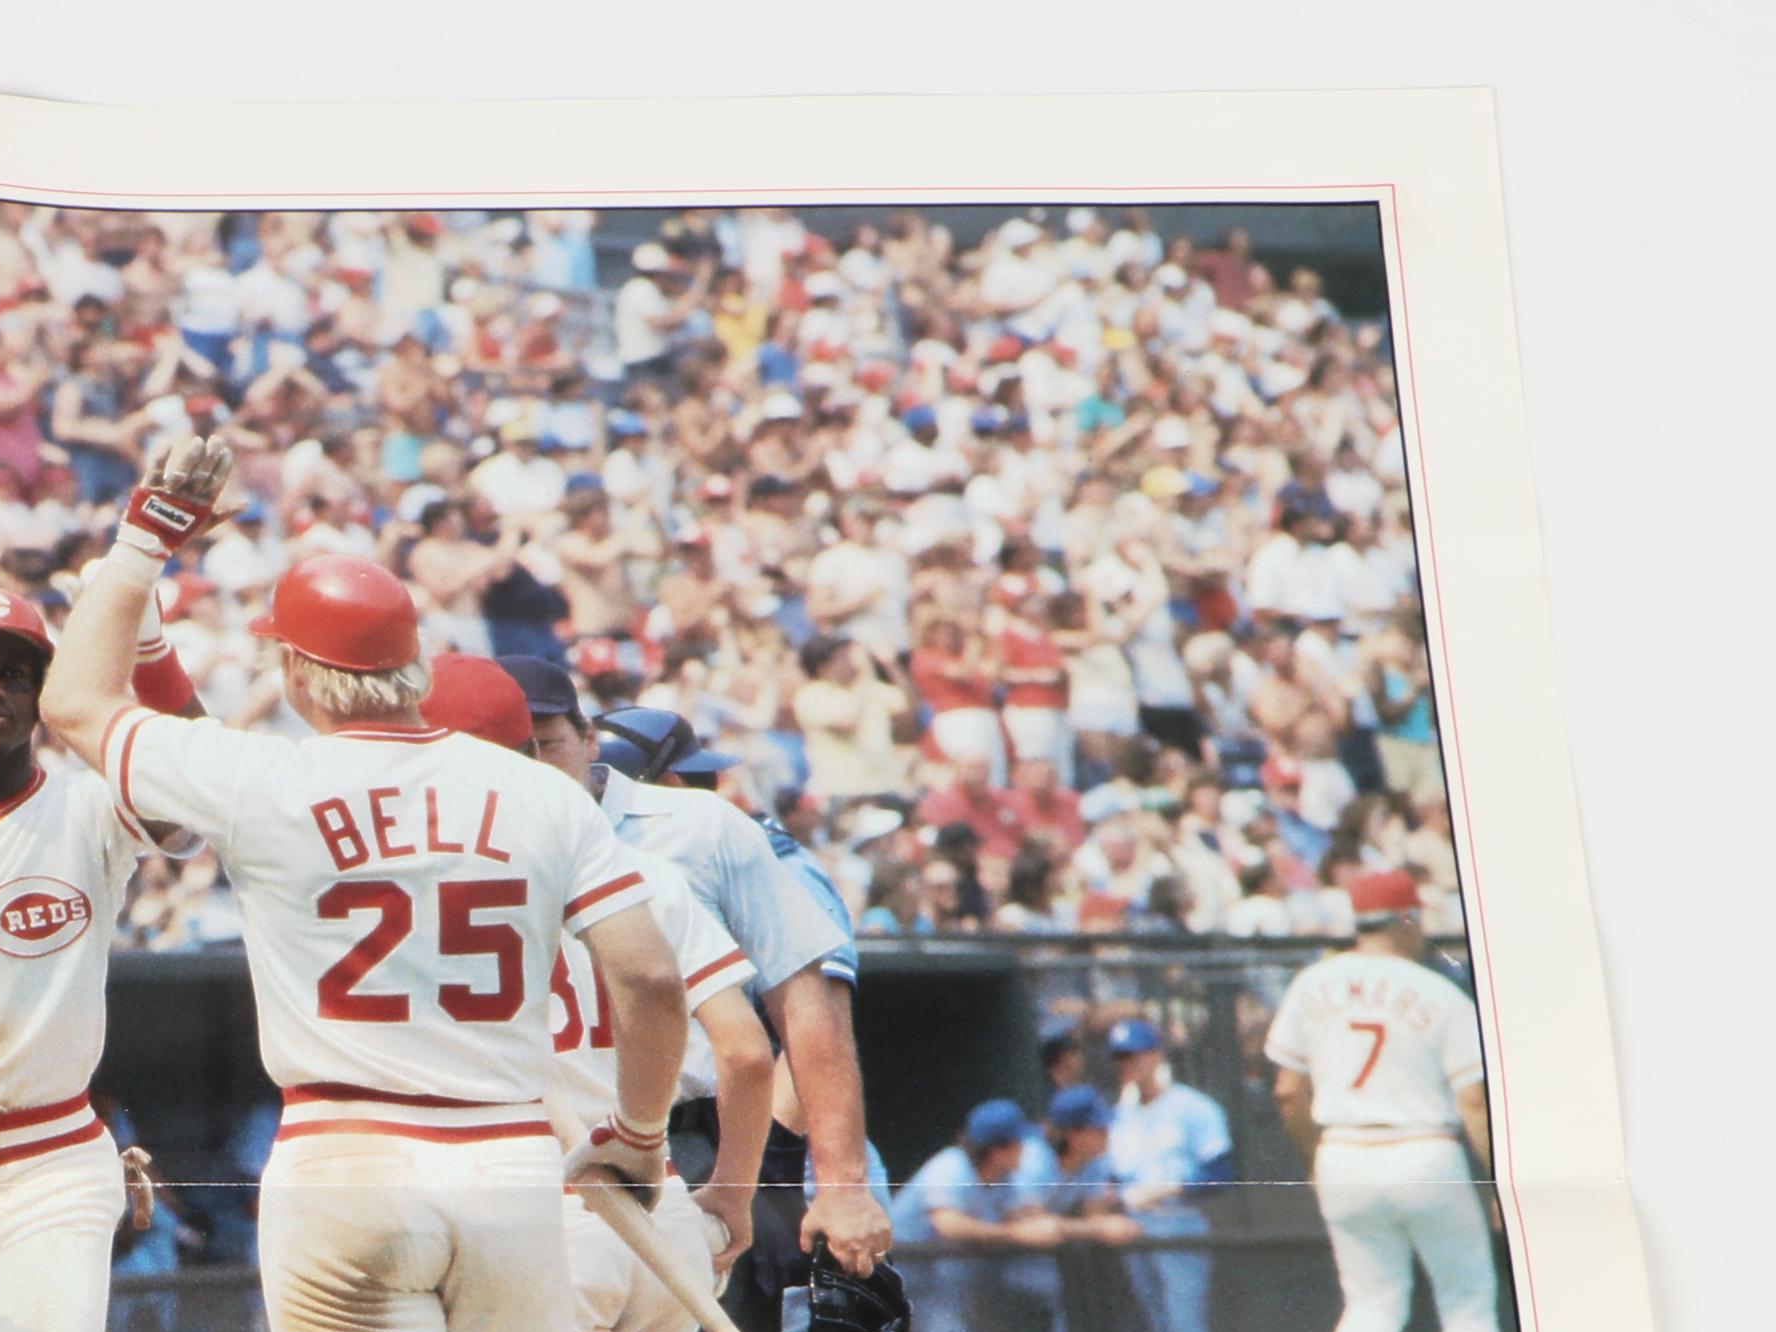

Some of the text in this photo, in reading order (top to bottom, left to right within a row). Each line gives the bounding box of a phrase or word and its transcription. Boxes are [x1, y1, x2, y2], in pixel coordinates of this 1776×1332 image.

[310, 786, 511, 872] BELL
[4, 898, 87, 933] REDS
[316, 878, 528, 1023] 25
[1349, 1021, 1387, 1089] 7
